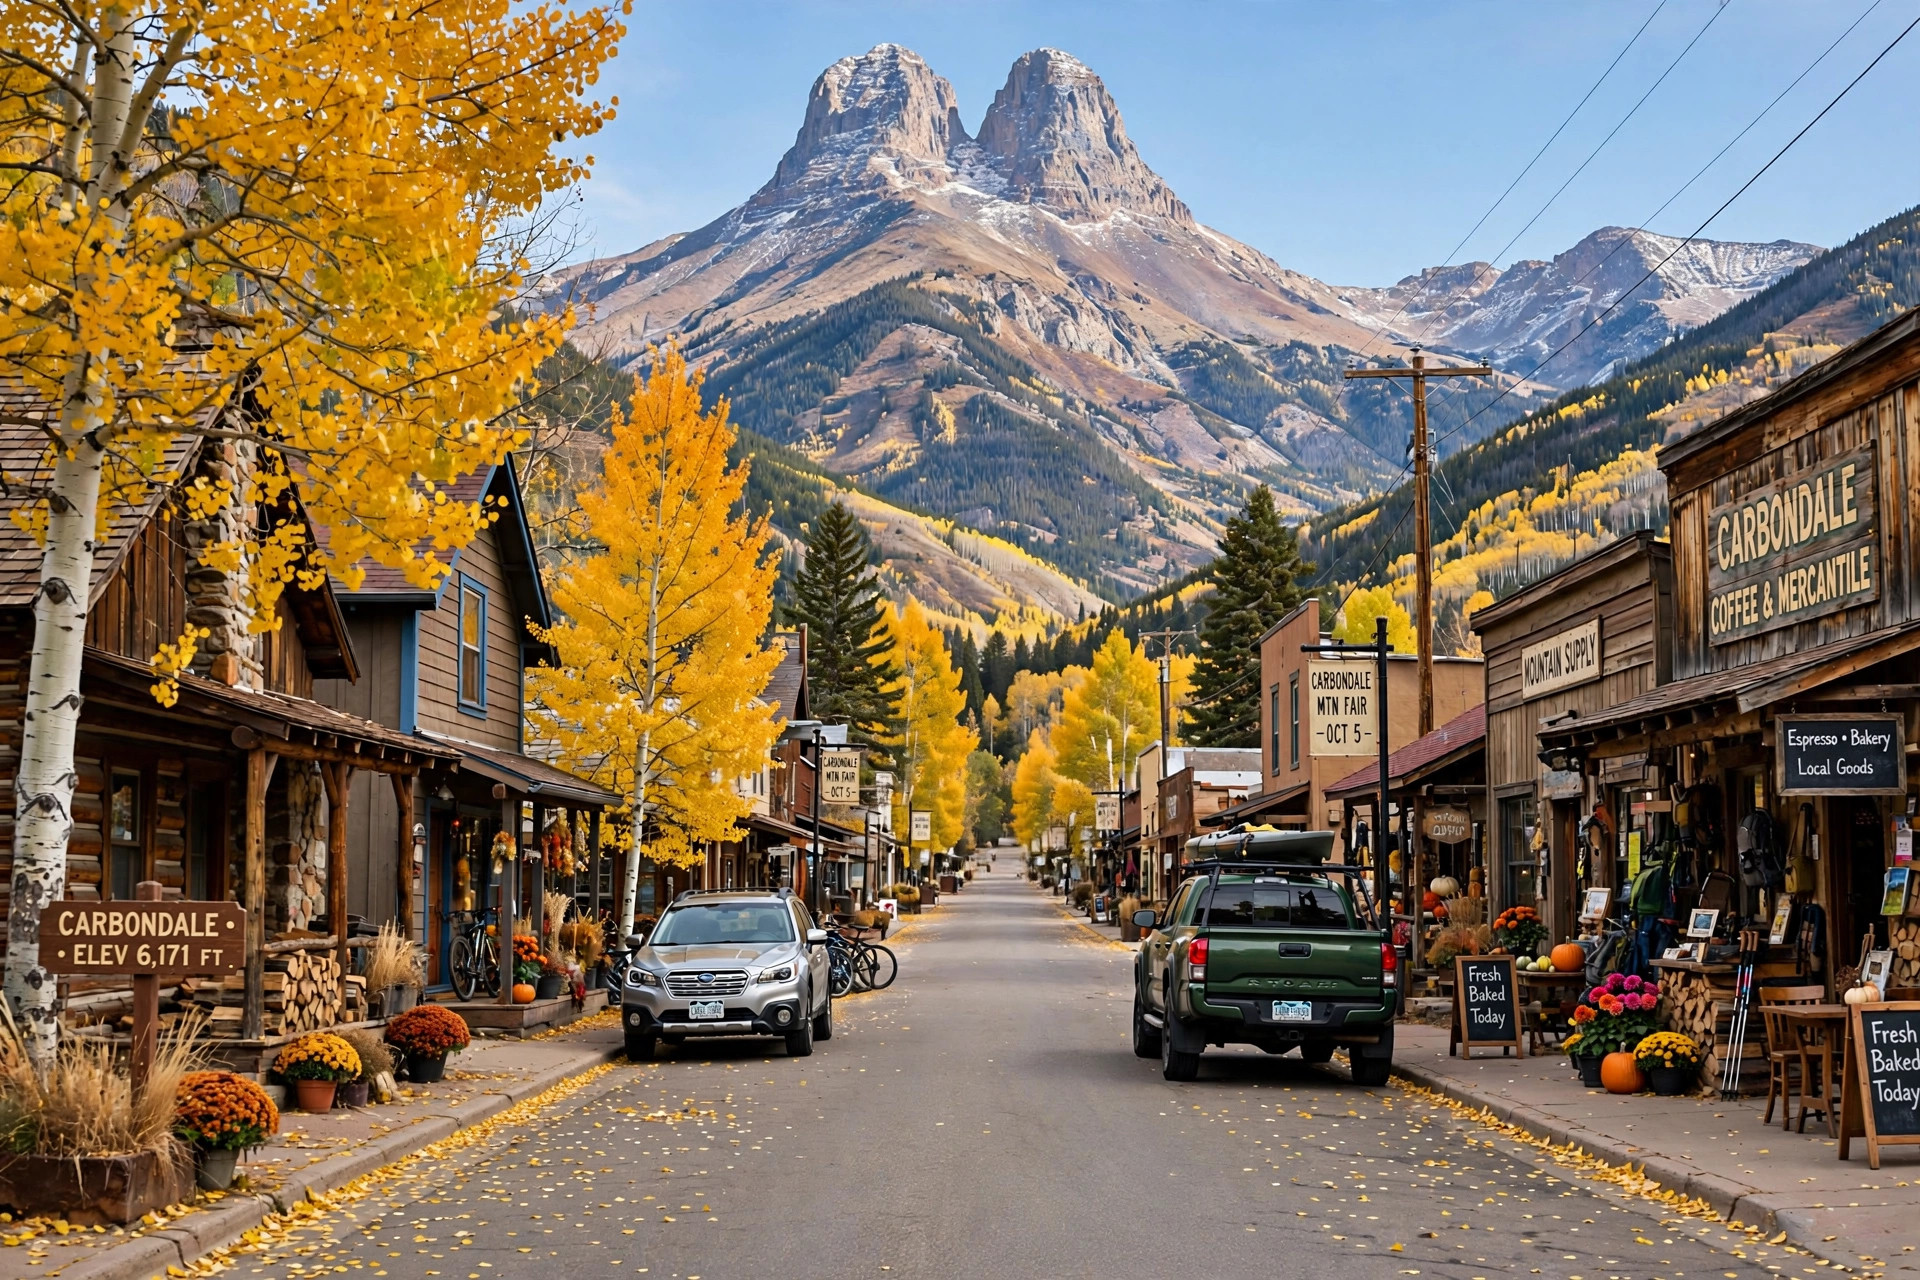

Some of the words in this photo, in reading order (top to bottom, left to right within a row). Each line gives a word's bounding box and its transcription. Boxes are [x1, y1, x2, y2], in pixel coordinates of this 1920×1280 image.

[1717, 463, 1858, 571] CARBONDALE
[1711, 584, 1759, 635] COFFEE
[1762, 580, 1773, 619] &
[1778, 546, 1871, 615] MERCANTILE
[1524, 646, 1562, 688] MOUNTAIN
[1565, 632, 1596, 674] SUPPLY
[1311, 671, 1371, 690] CARBONDALE
[1317, 696, 1339, 715] MTN
[1344, 696, 1367, 715] FAIR
[1326, 723, 1348, 743] OCT
[1354, 724, 1361, 743] 5
[1788, 729, 1838, 751] Espresso
[1850, 729, 1891, 752] Bakery
[826, 771, 840, 782] MTN
[841, 771, 856, 782] FAIR
[1798, 758, 1830, 775] Local
[1836, 758, 1874, 775] Goods
[58, 911, 219, 937] CARBONDALE
[73, 944, 128, 965] ELEV
[136, 944, 189, 968] 6,171
[200, 949, 223, 966] FT
[1468, 965, 1501, 982] Fresh
[1469, 985, 1505, 1003] Baked
[1470, 1008, 1506, 1029] Today
[1871, 1020, 1918, 1044] Fresh
[1870, 1048, 1920, 1073] Baked
[1873, 1079, 1920, 1110] Today
